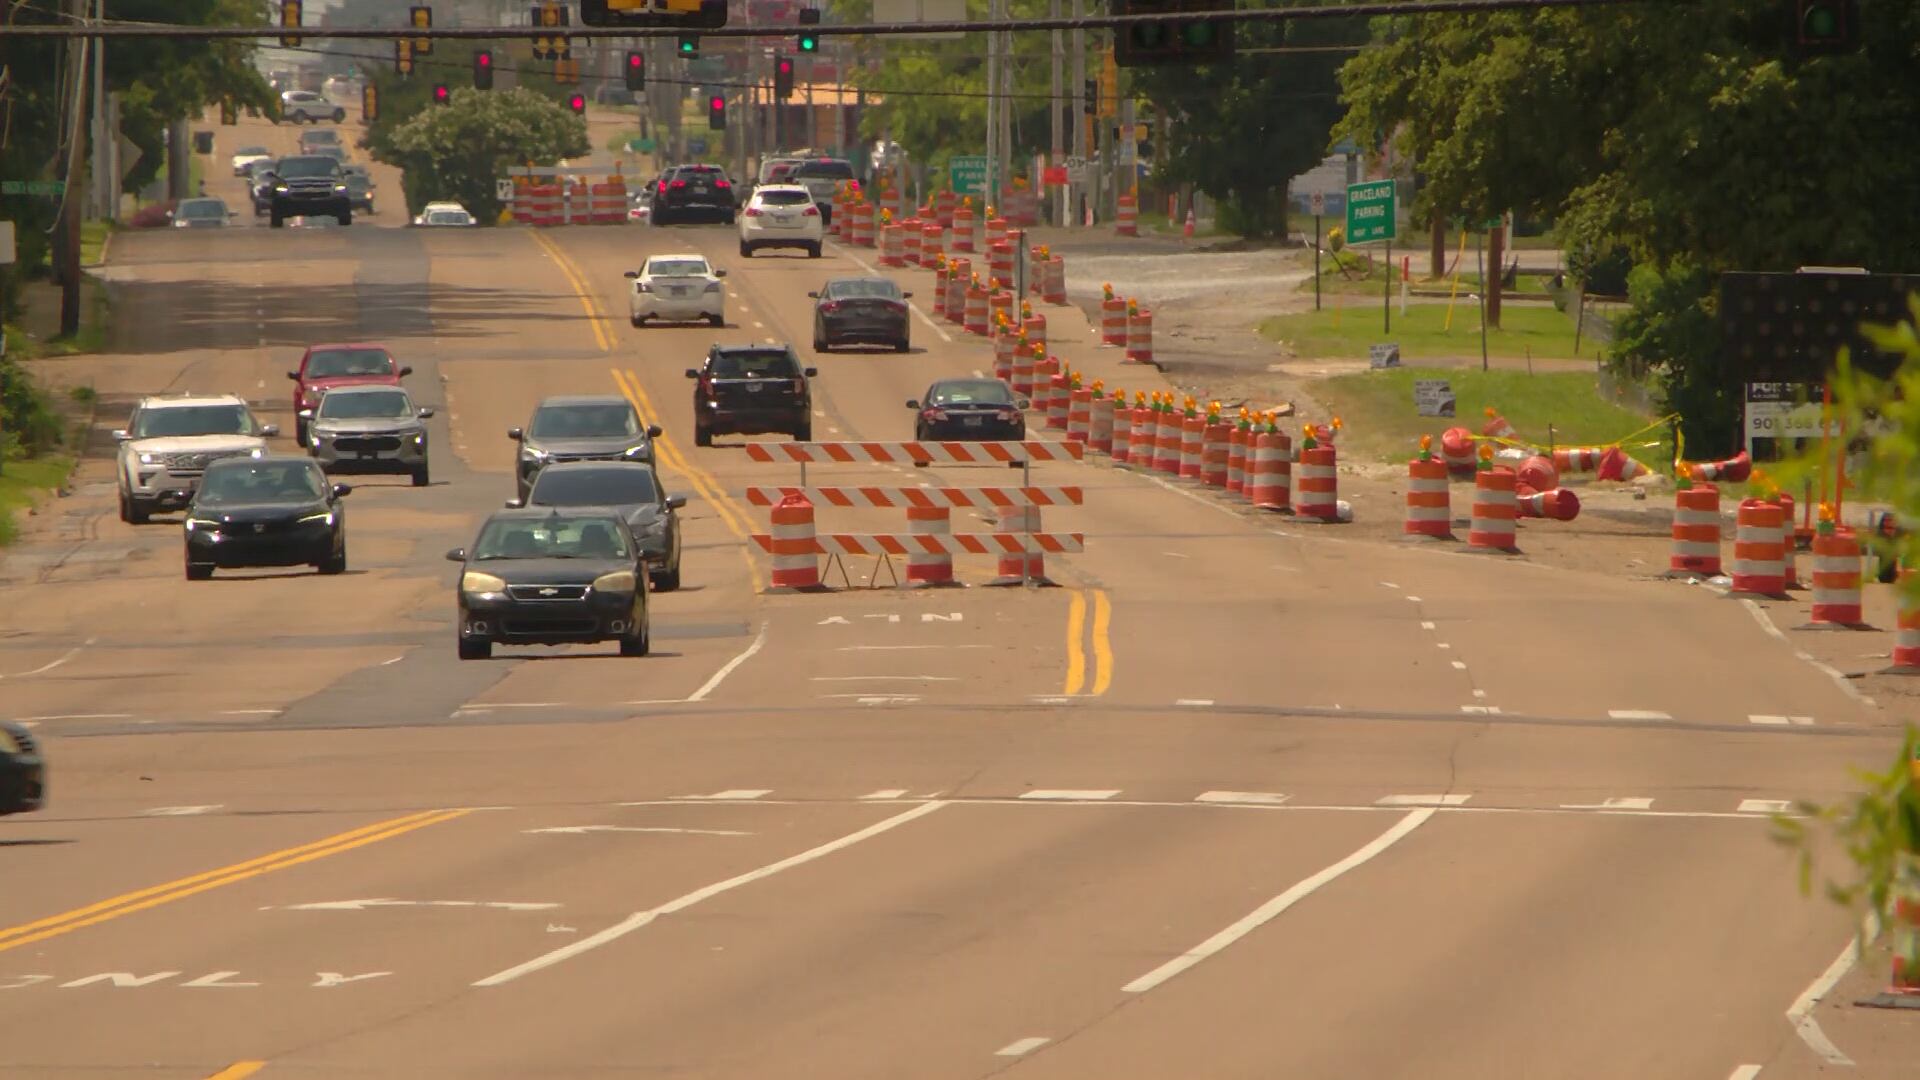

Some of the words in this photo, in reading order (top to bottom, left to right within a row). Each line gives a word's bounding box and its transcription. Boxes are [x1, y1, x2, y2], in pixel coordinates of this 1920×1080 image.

[1351, 186, 1391, 202] GRACELAND
[1354, 205, 1384, 220] PARKING
[817, 612, 1010, 625] NLY
